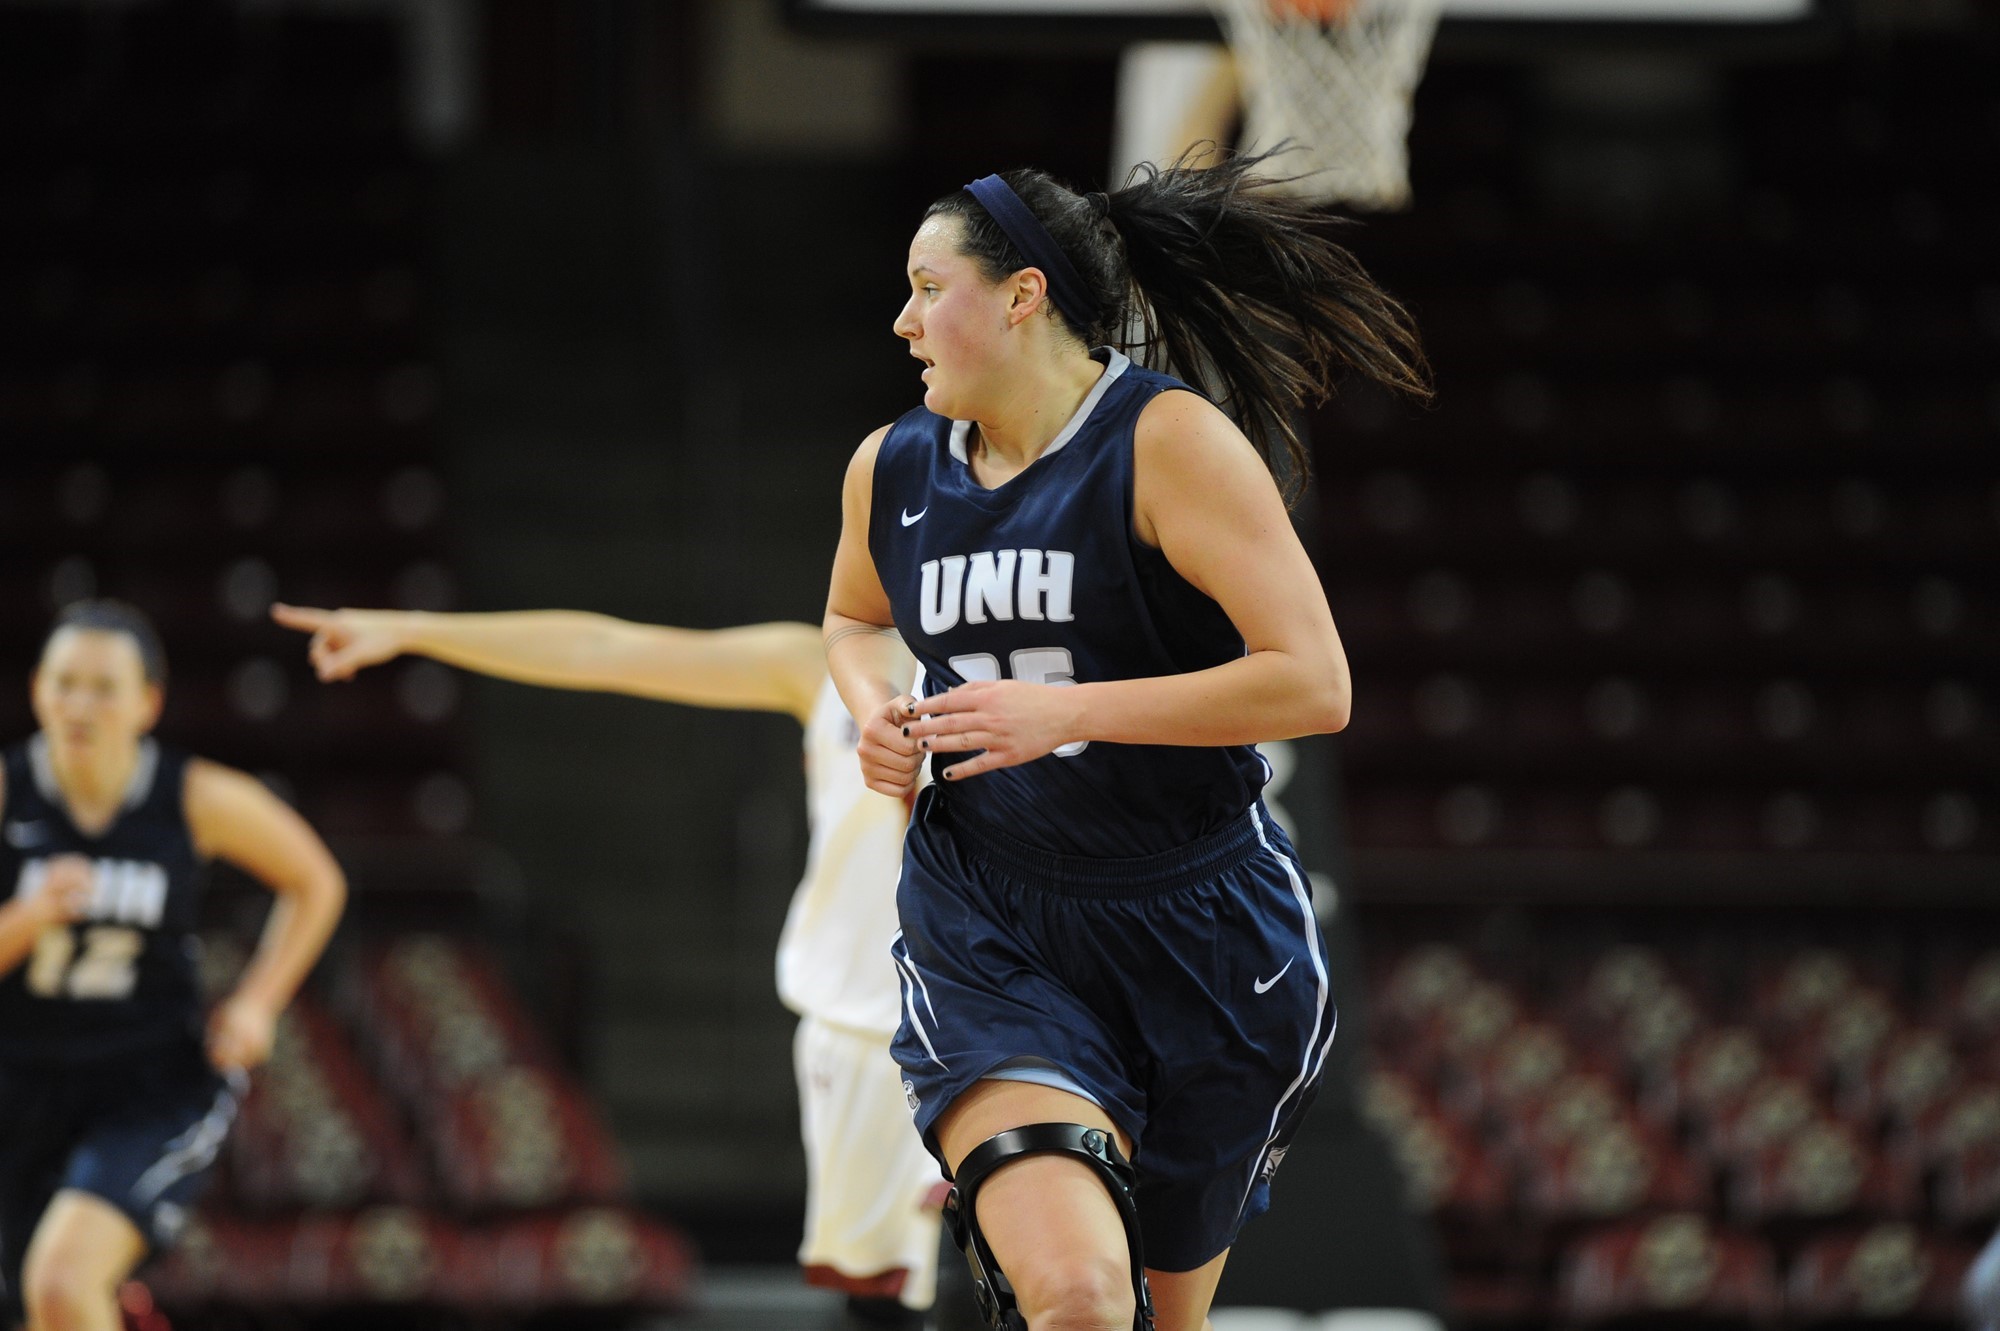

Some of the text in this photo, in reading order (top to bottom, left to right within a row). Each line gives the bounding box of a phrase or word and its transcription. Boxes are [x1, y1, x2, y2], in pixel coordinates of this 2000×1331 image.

[920, 549, 1075, 635] UNH
[948, 647, 1090, 758] 5
[27, 925, 143, 997] 12
